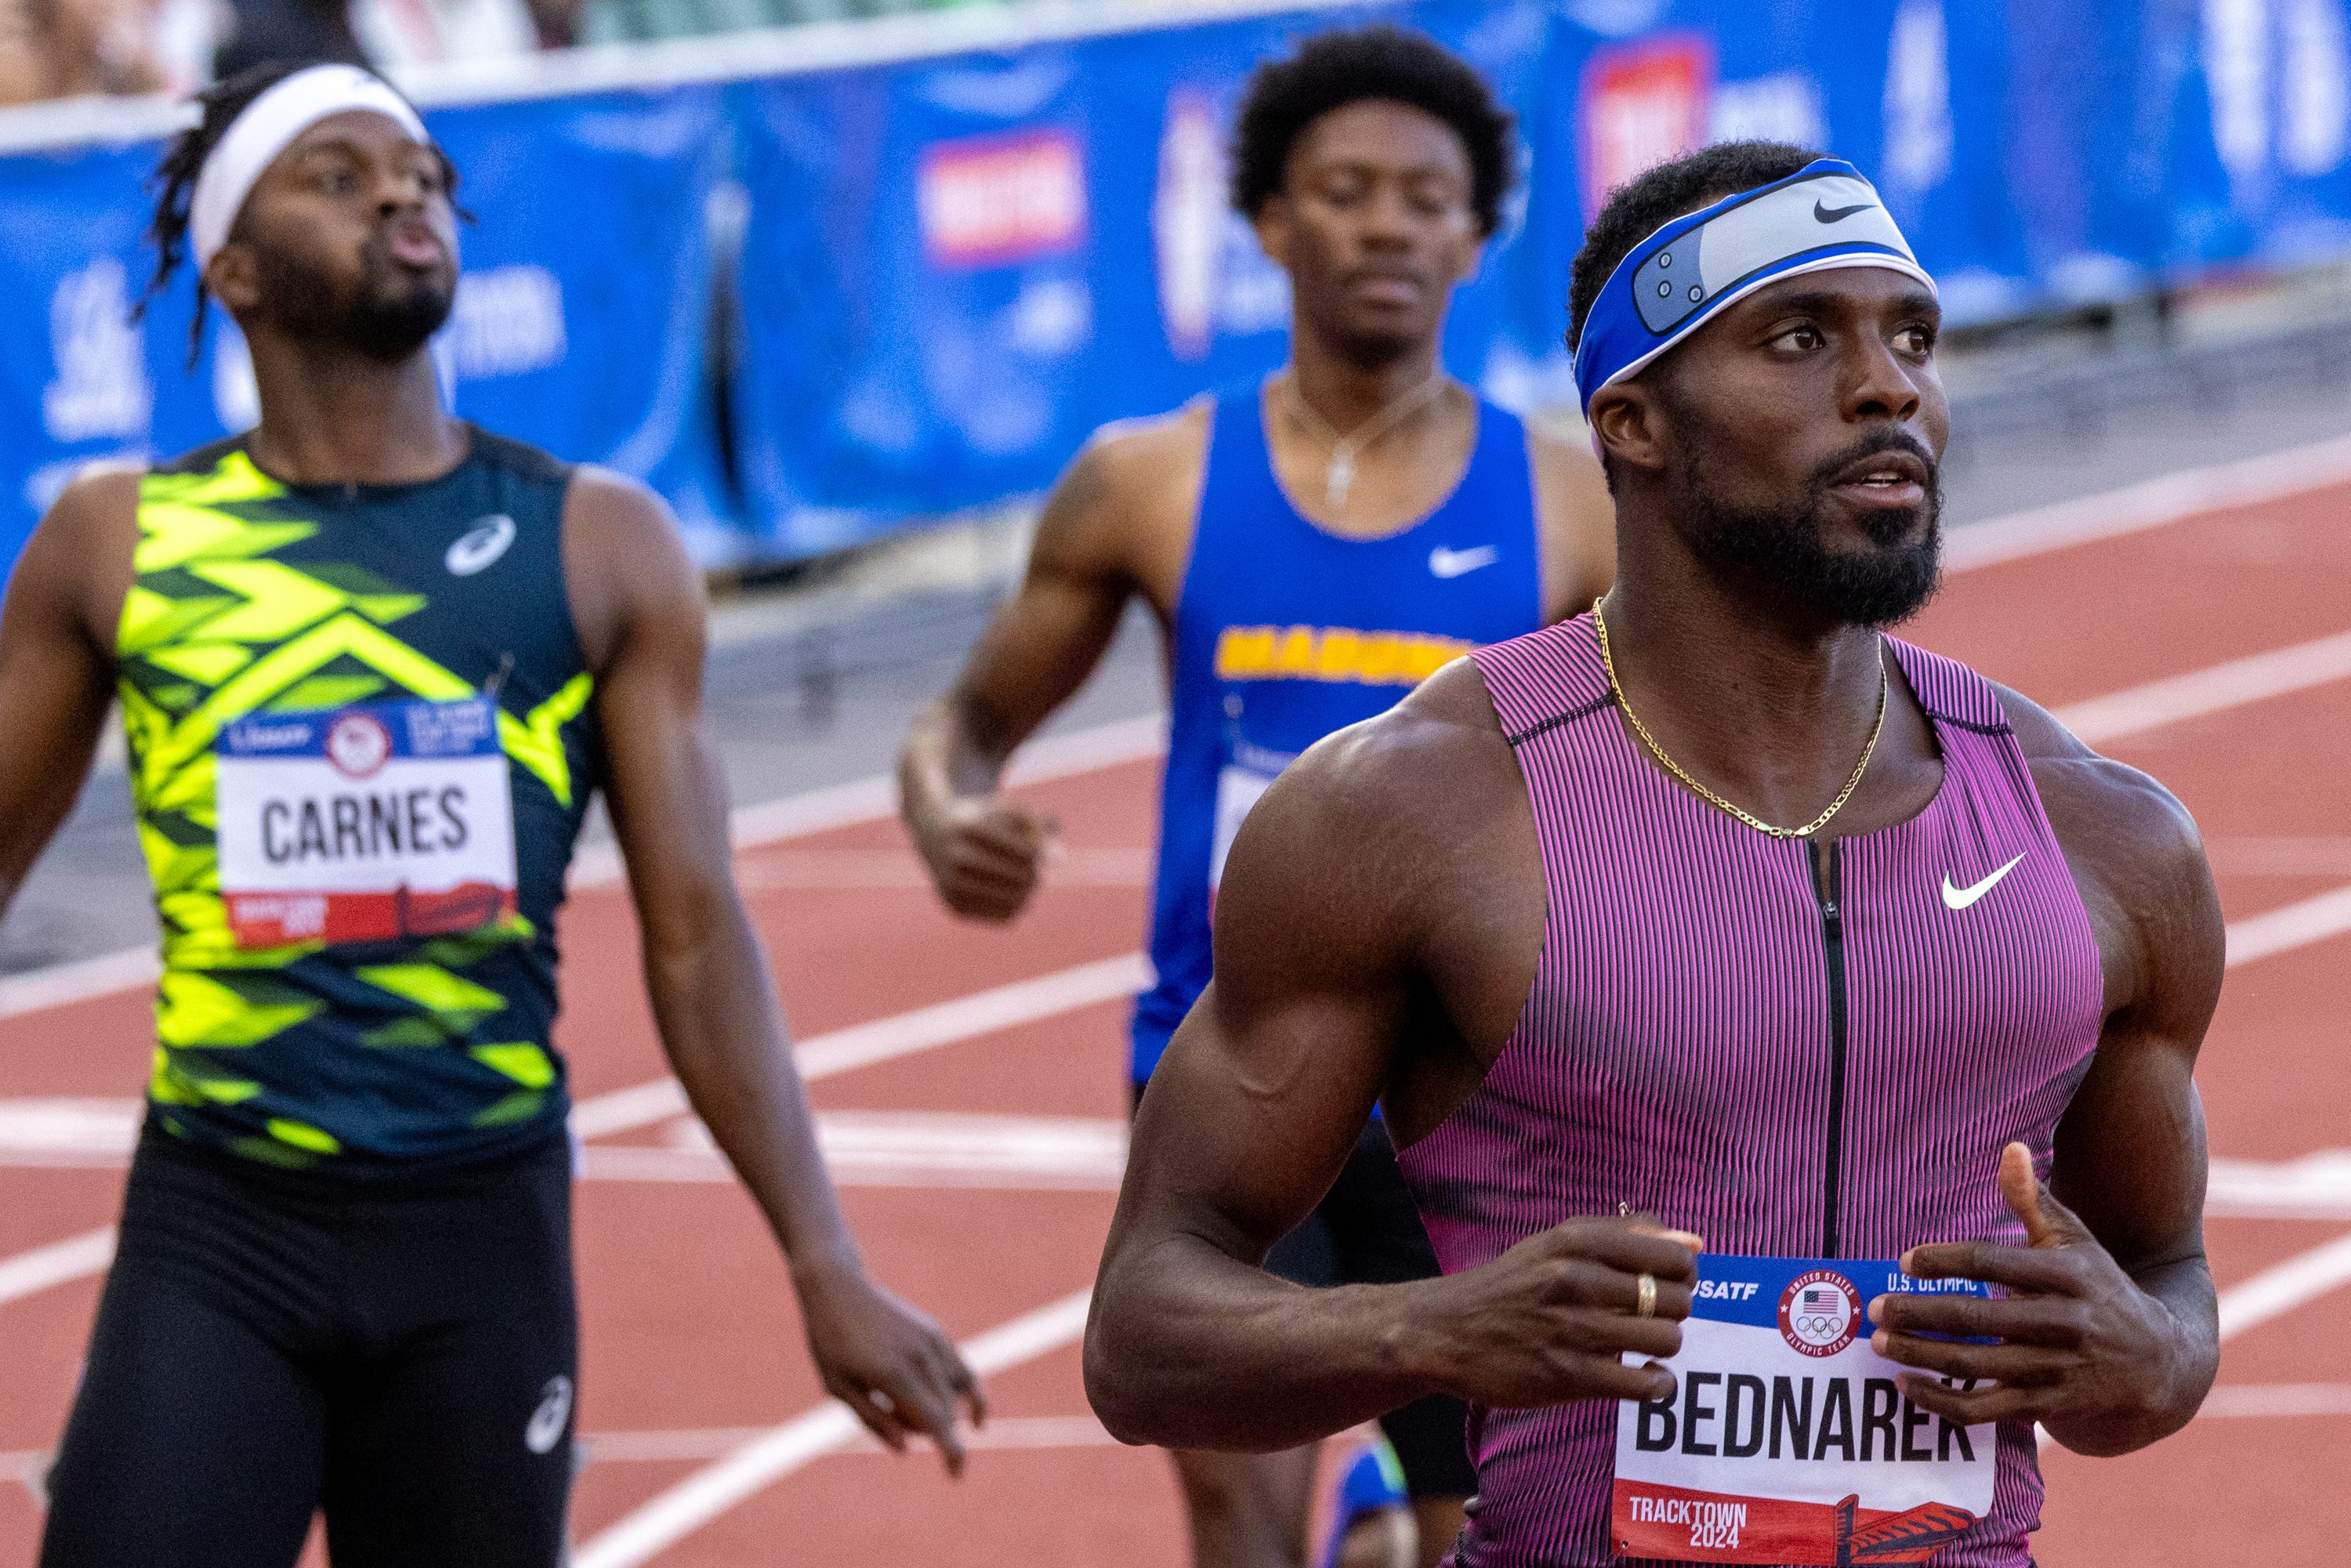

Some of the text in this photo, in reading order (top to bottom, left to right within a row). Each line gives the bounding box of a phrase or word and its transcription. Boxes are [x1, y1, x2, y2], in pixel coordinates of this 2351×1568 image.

[261, 787, 468, 864] CARNES
[1788, 1272, 1855, 1296] UNITED STATES
[1887, 1273, 1914, 1291] U.S.
[1786, 1331, 1851, 1356] OLYMPIC TEAM
[1636, 1371, 1977, 1462] BEDNAREK
[1630, 1497, 1747, 1528] TRACKTOWN
[1690, 1523, 1741, 1548] 2024
